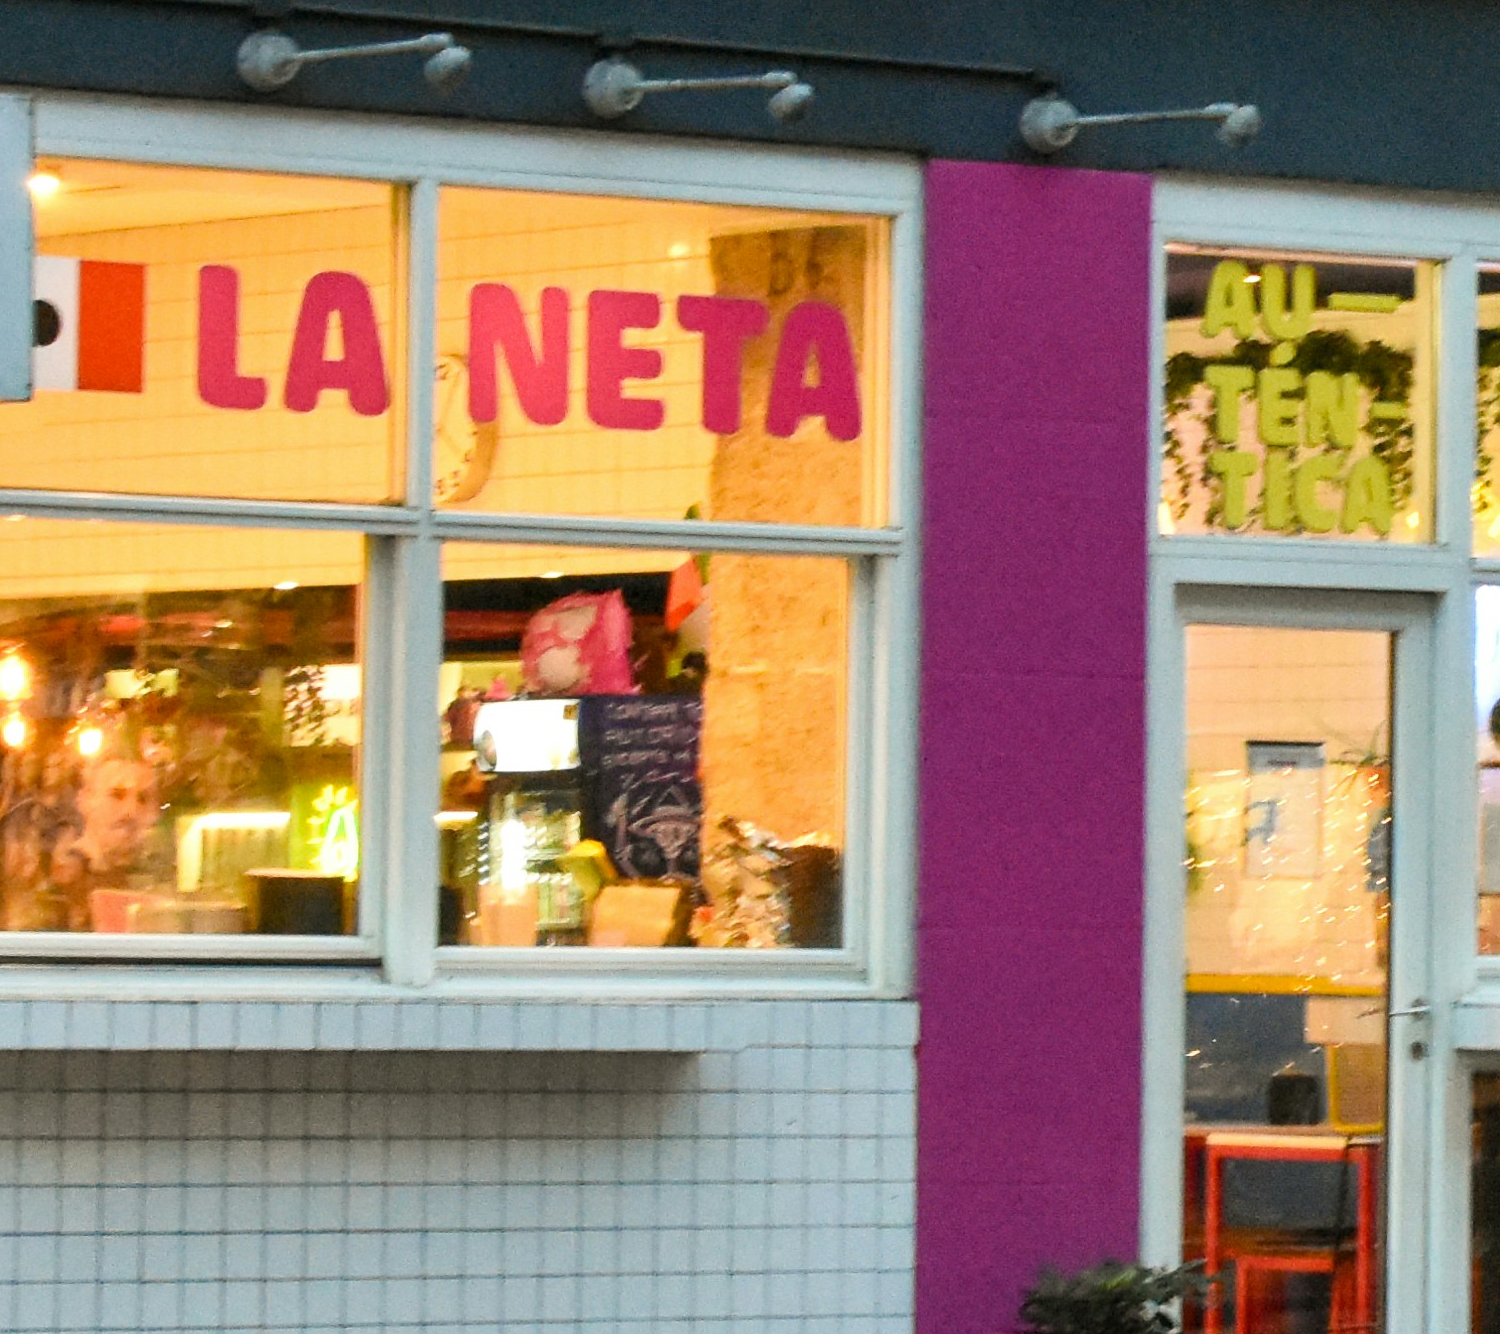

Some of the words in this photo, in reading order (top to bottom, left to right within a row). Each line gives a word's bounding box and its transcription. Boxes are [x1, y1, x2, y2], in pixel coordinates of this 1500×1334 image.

[196, 264, 391, 419] LA
[466, 281, 863, 443] NETA
[1208, 448, 1391, 535] TICA
